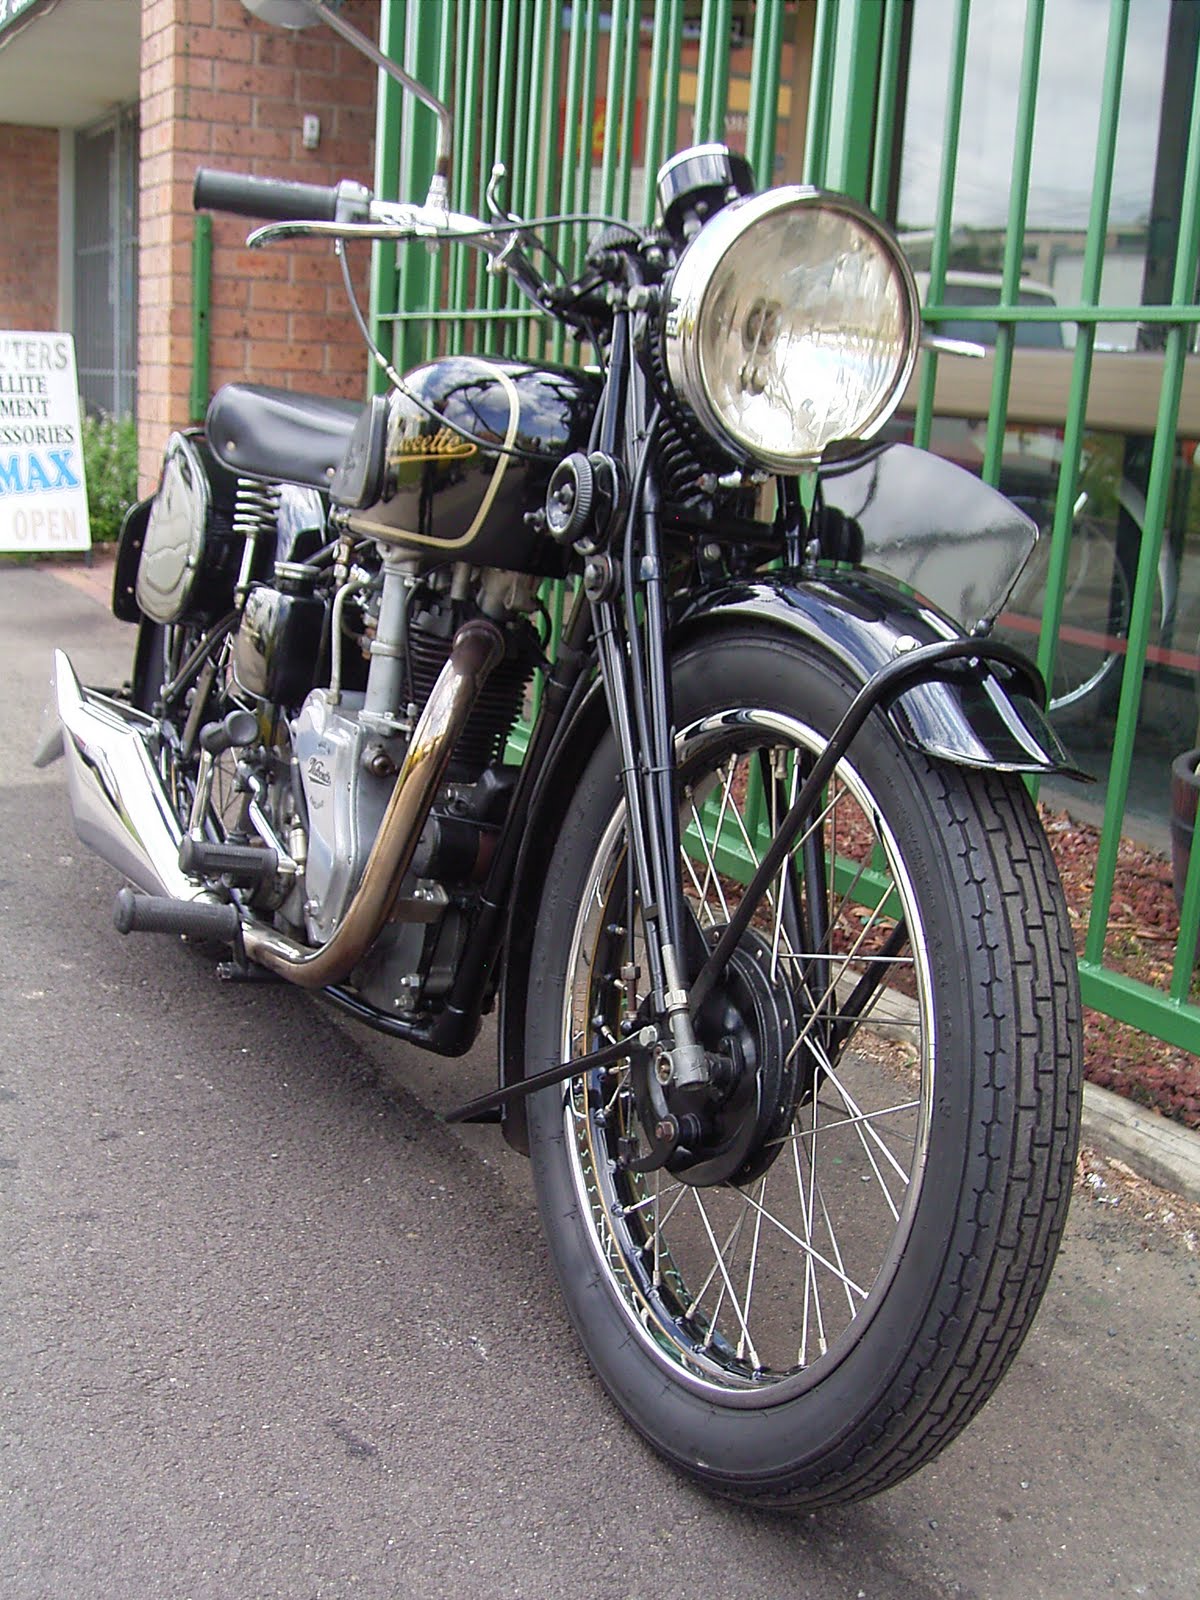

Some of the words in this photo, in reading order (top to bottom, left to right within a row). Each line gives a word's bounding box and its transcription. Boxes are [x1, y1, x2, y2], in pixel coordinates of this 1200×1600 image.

[0, 426, 74, 445] SSORIES
[0, 450, 79, 493] MAX
[14, 509, 77, 541] OPEN
